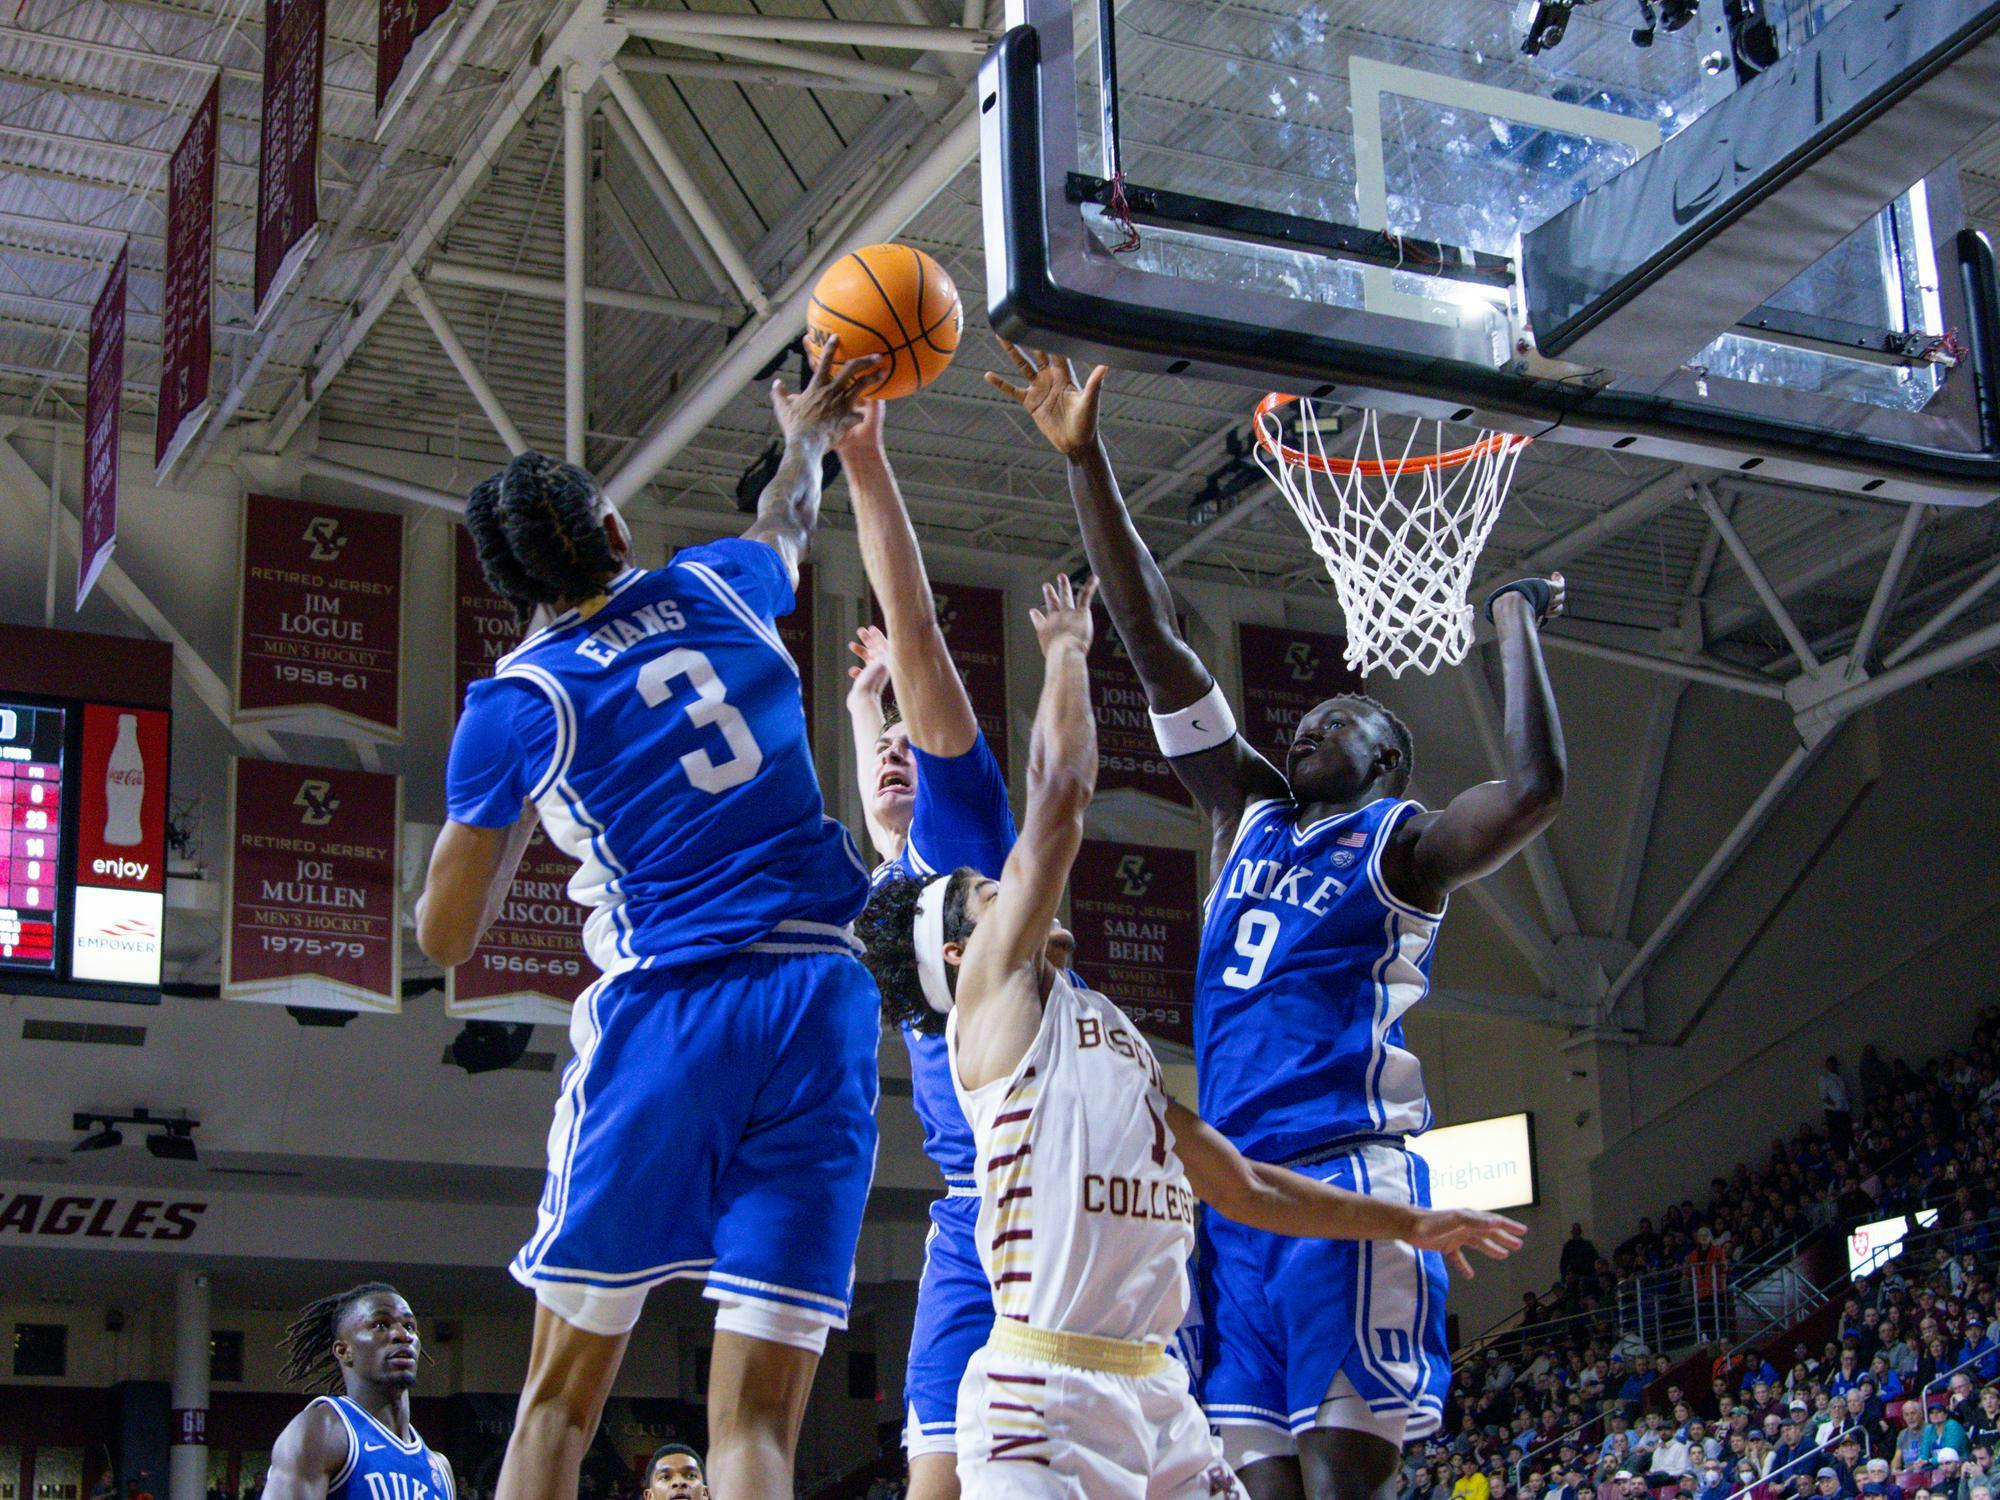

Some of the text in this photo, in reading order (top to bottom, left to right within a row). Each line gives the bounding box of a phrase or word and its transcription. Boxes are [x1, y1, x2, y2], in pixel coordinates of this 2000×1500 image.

[251, 567, 394, 596] RETIRED JERSEY
[305, 593, 340, 615] JIM
[280, 613, 364, 641] LOGUE
[575, 599, 687, 668] EVANS
[263, 640, 377, 667] MEN'S HOCKEY
[274, 665, 367, 690] 1958-61
[635, 647, 763, 795] 3
[1099, 756, 1169, 775] 963-66
[241, 834, 387, 860] RETIRED JERSEY
[92, 857, 149, 880] enjoy
[297, 860, 334, 881] JOE
[535, 863, 577, 875] JERS
[261, 880, 367, 909] MULLEN
[511, 880, 563, 900] ERRY
[1226, 858, 1347, 917] DUKE
[255, 911, 371, 932] MEN'S HOCKEY
[499, 900, 584, 926] RISCOLL
[1076, 901, 1192, 920] RETIRED JERSEY
[511, 932, 582, 949] BASKETBA
[1104, 919, 1168, 941] SARAH
[77, 936, 156, 953] EMPOWER
[261, 936, 365, 958] 1975-79
[1109, 940, 1164, 962] BEHN
[1222, 908, 1281, 990] 9
[482, 954, 580, 976] 1966-69
[1144, 1094, 1167, 1168] 1
[1084, 1175, 1194, 1223] COLLEG
[0, 1193, 208, 1240] AGLES
[1375, 1328, 1411, 1363] D
[364, 1472, 437, 1500] DUK
